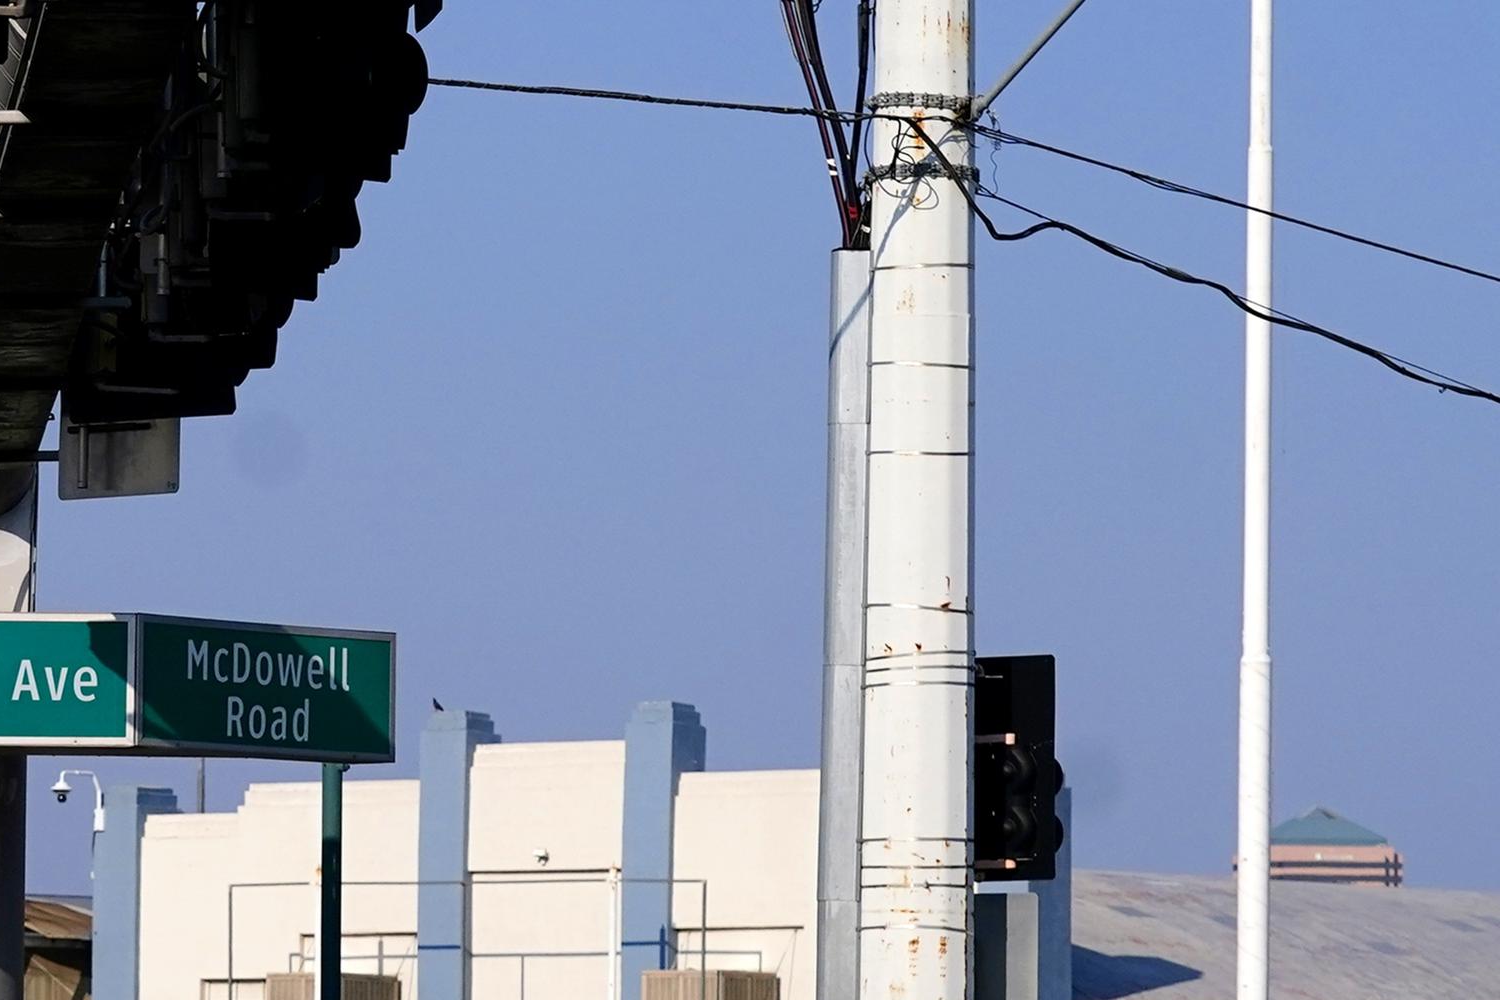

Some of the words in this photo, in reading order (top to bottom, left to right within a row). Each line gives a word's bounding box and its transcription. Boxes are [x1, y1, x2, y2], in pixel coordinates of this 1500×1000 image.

[11, 659, 99, 703] Ave
[186, 639, 350, 692] McDowell
[226, 696, 310, 742] Road
